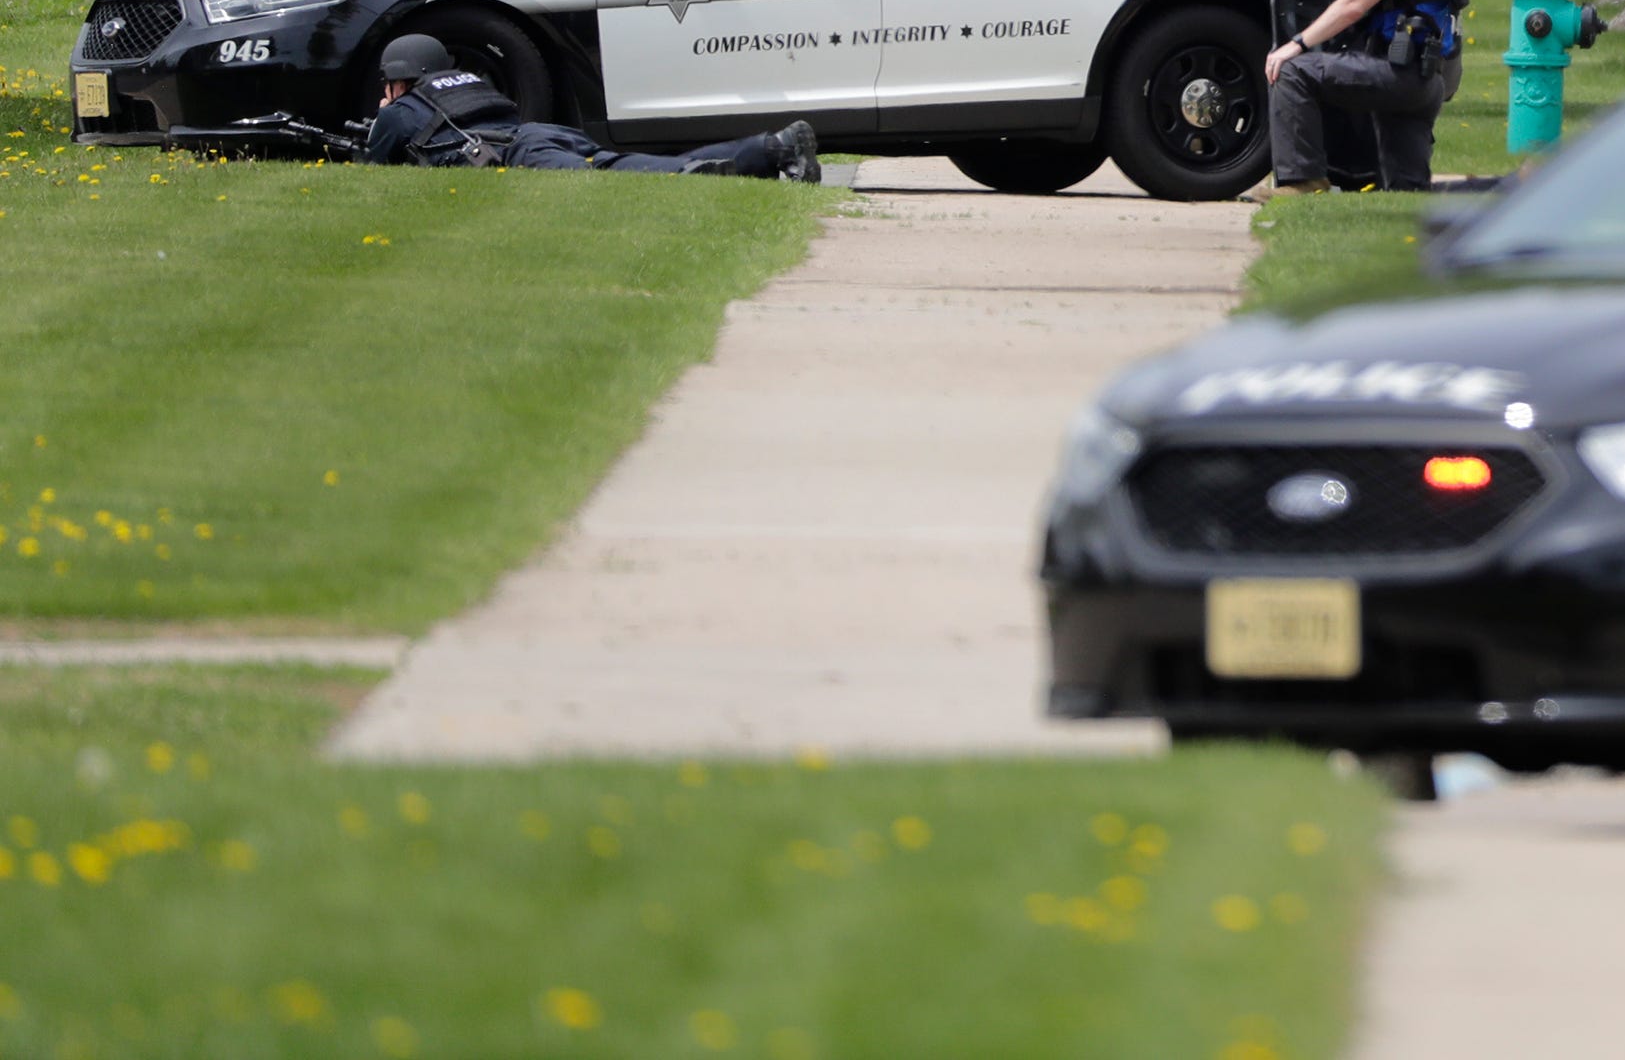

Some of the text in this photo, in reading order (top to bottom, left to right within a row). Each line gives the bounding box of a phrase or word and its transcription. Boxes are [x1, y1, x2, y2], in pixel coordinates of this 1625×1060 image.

[692, 18, 1071, 57] COMPASSION INTEGRITY COURAGE
[220, 39, 270, 63] 945
[432, 73, 481, 89] POLICE
